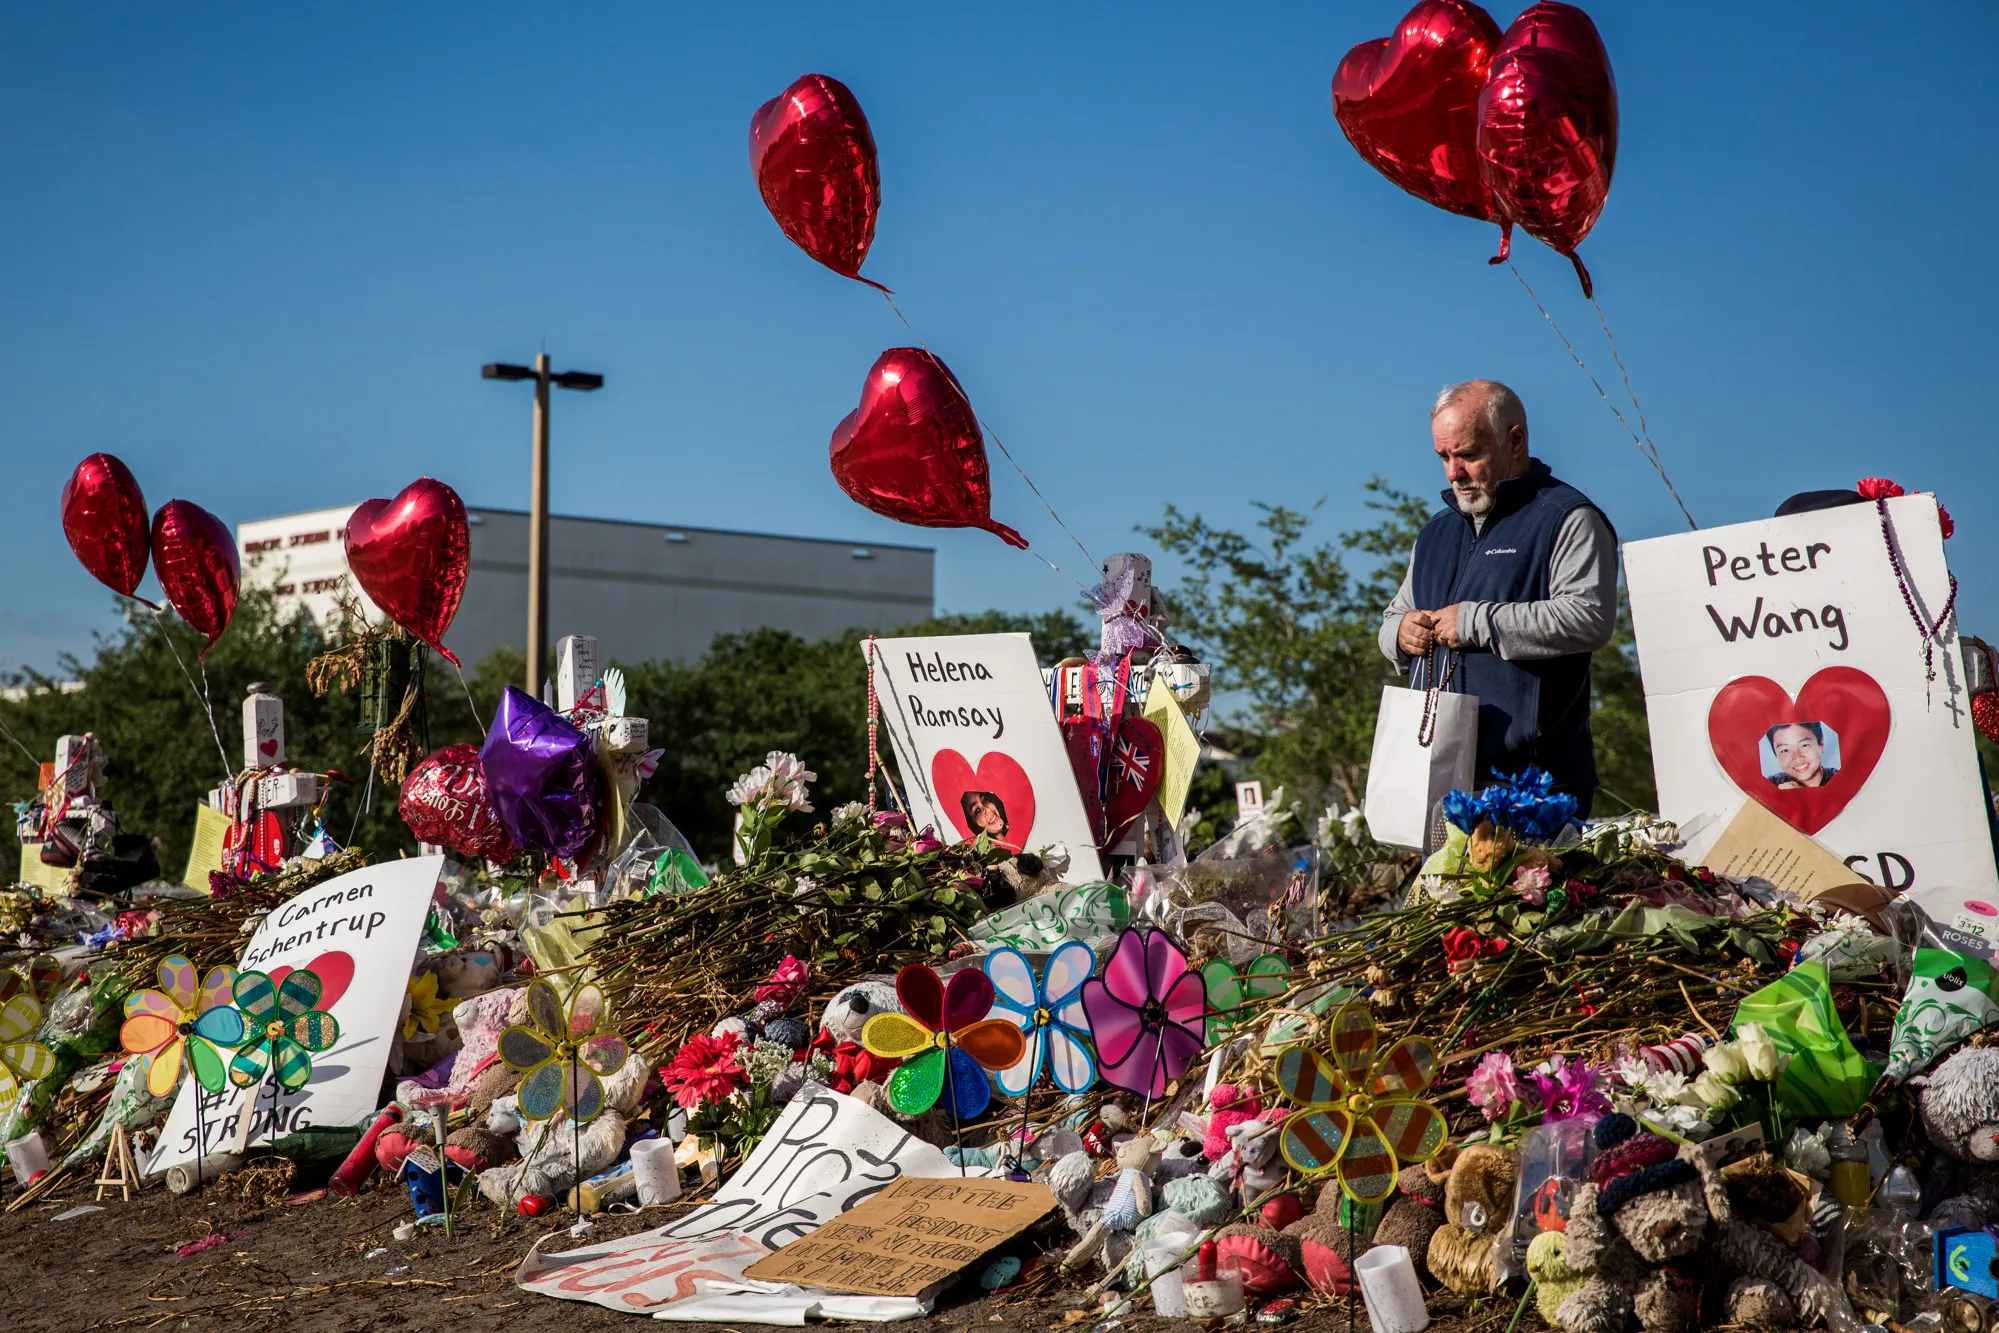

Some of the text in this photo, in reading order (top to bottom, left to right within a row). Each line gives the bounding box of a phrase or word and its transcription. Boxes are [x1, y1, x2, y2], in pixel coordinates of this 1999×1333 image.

[1491, 547, 1517, 555] Columbia
[1703, 542, 1832, 587] Peter
[1705, 596, 1849, 651] Wang
[904, 652, 994, 685] Helena
[907, 694, 1005, 740] Ramsay
[1843, 852, 1915, 892] SD
[278, 884, 374, 928] Carmen
[1942, 930, 1984, 950] ROSES
[1958, 920, 1966, 929] 3
[242, 911, 386, 972] Schentrup
[1943, 973, 1964, 987] ublix
[178, 1106, 313, 1154] STRONG
[888, 1180, 1028, 1211] WHEN THE
[813, 1222, 886, 1244] NEEDS
[885, 1200, 1006, 1244] PRESIDENT
[785, 1241, 829, 1259] ON
[777, 1259, 814, 1277] IS
[804, 1264, 834, 1279] A
